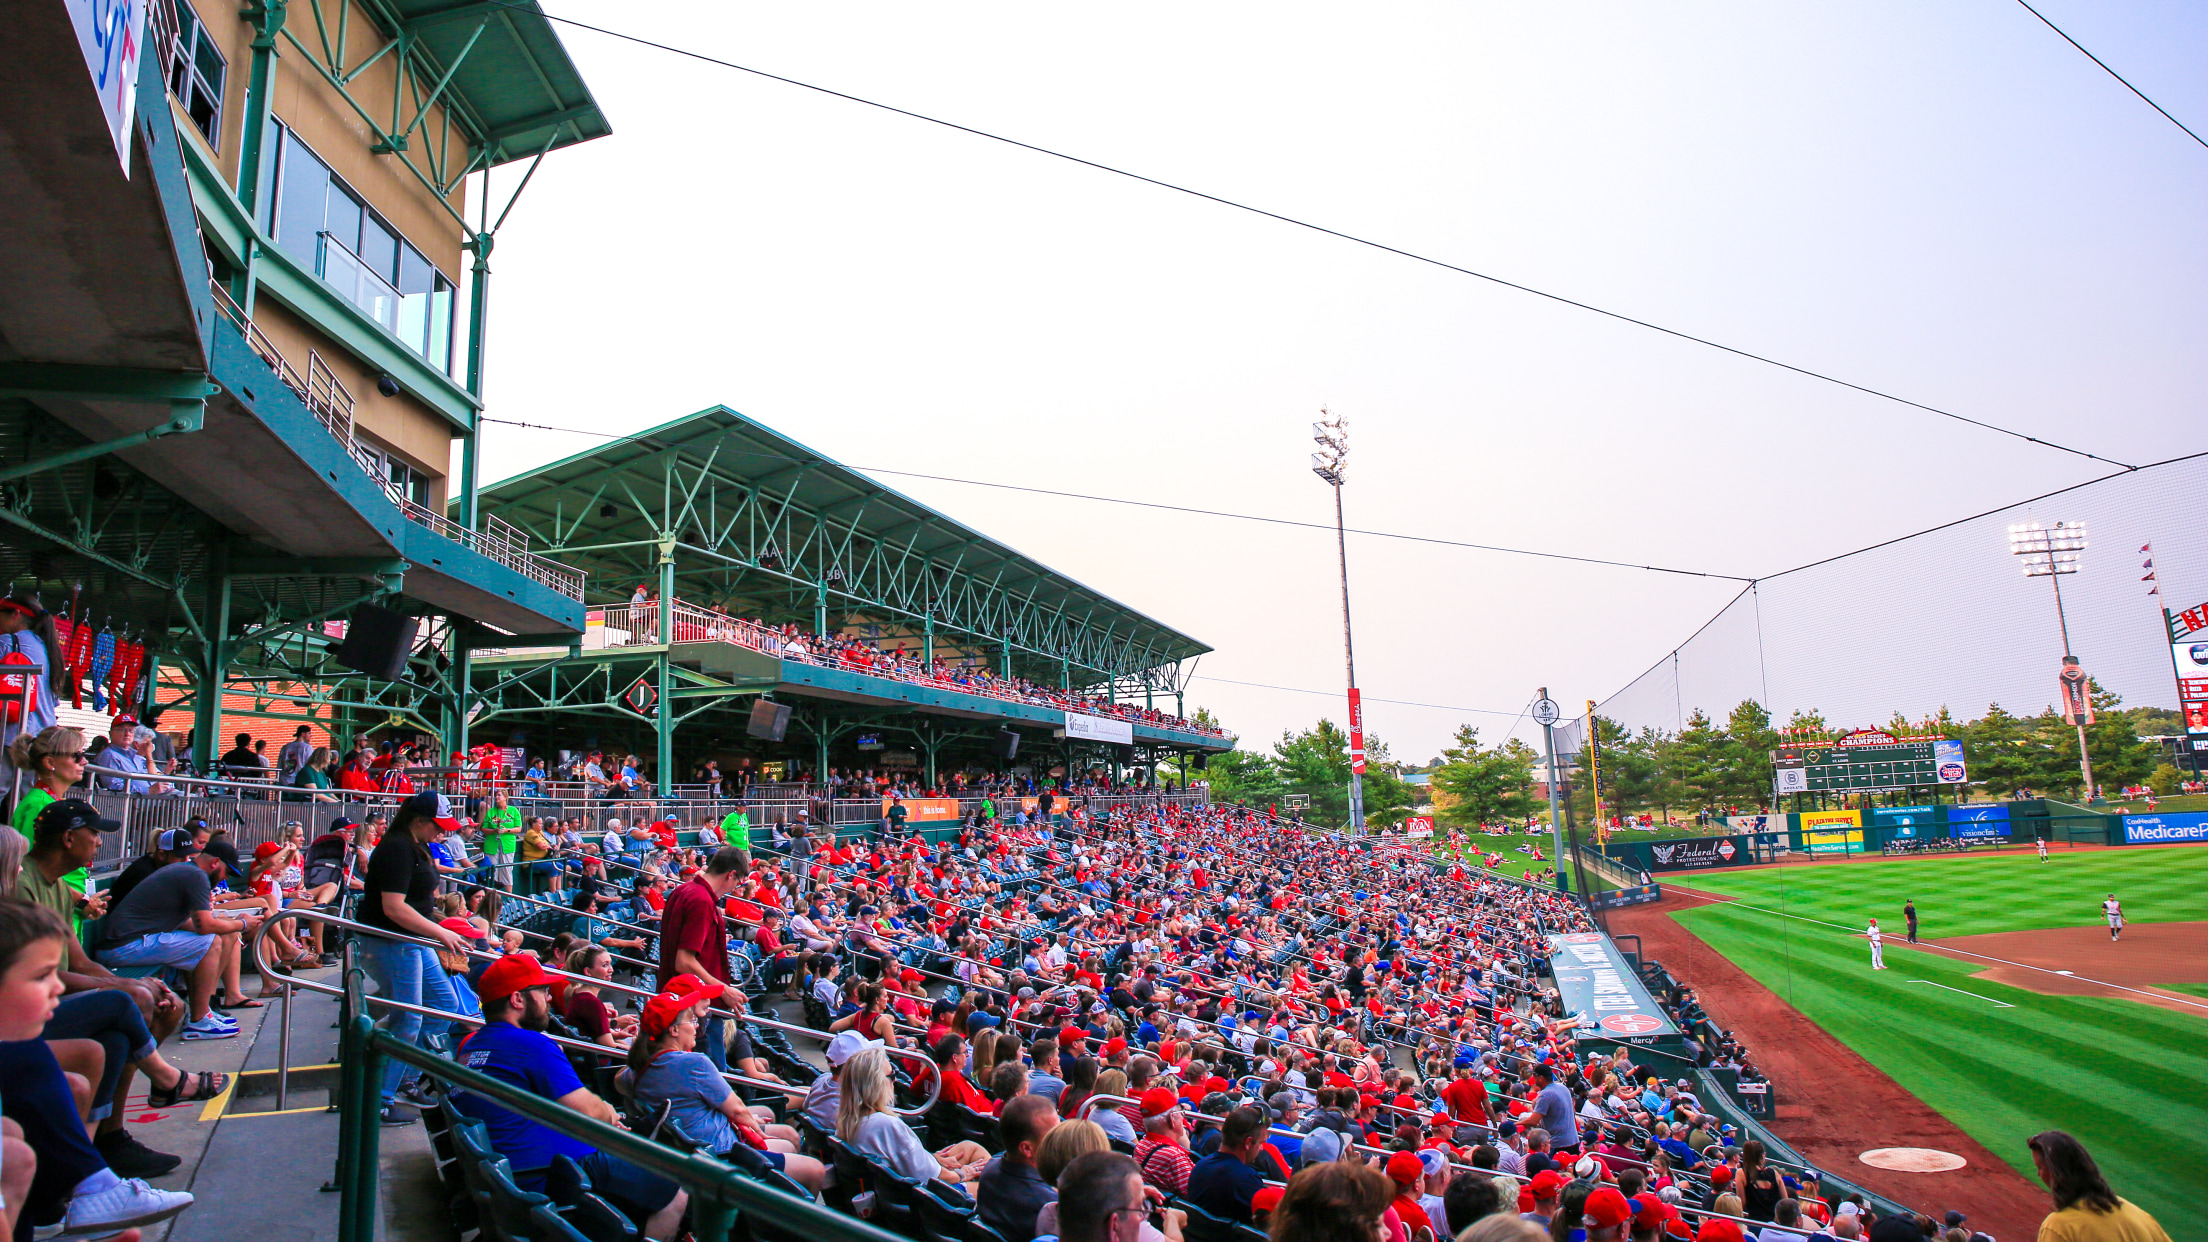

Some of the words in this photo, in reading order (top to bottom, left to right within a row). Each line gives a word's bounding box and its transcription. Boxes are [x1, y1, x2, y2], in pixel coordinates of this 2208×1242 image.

[637, 686, 645, 707] J
[1840, 737, 1895, 746] CHAMPIONS
[923, 805, 931, 814] this
[932, 805, 936, 814] is
[1409, 818, 1430, 830] RYAN
[1835, 816, 1854, 826] SERVICE
[2126, 817, 2161, 825] CoxHealth
[1676, 841, 1718, 858] Federal
[1593, 994, 1641, 1011] FIELD
[1630, 1036, 1654, 1045] Mercy
